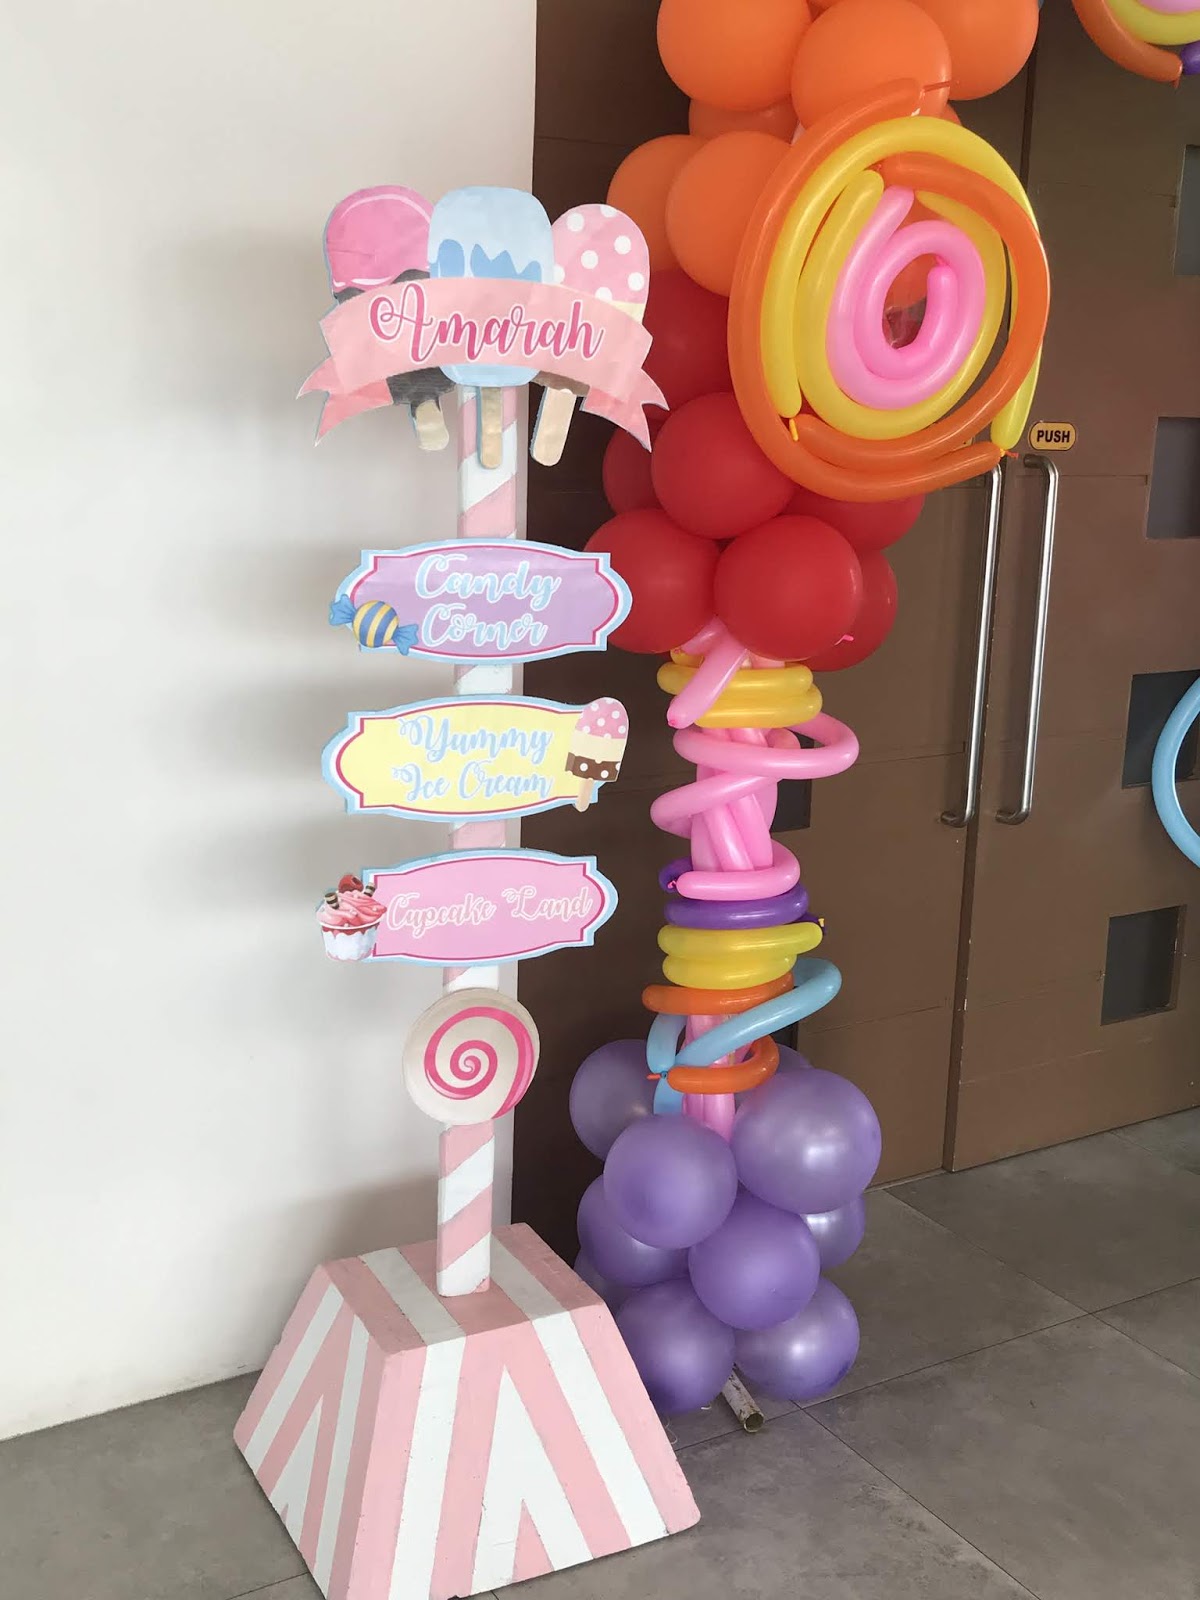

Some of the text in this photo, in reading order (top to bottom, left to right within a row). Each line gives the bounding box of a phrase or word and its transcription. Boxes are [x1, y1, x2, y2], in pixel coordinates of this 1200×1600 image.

[369, 282, 604, 363] Amarah
[1036, 429, 1070, 443] PUSH
[415, 554, 562, 611] Candy
[421, 603, 548, 650] Corner
[398, 714, 554, 765] Yummy
[391, 759, 555, 802] Ice Cream
[386, 885, 593, 939] Cupcake Land
